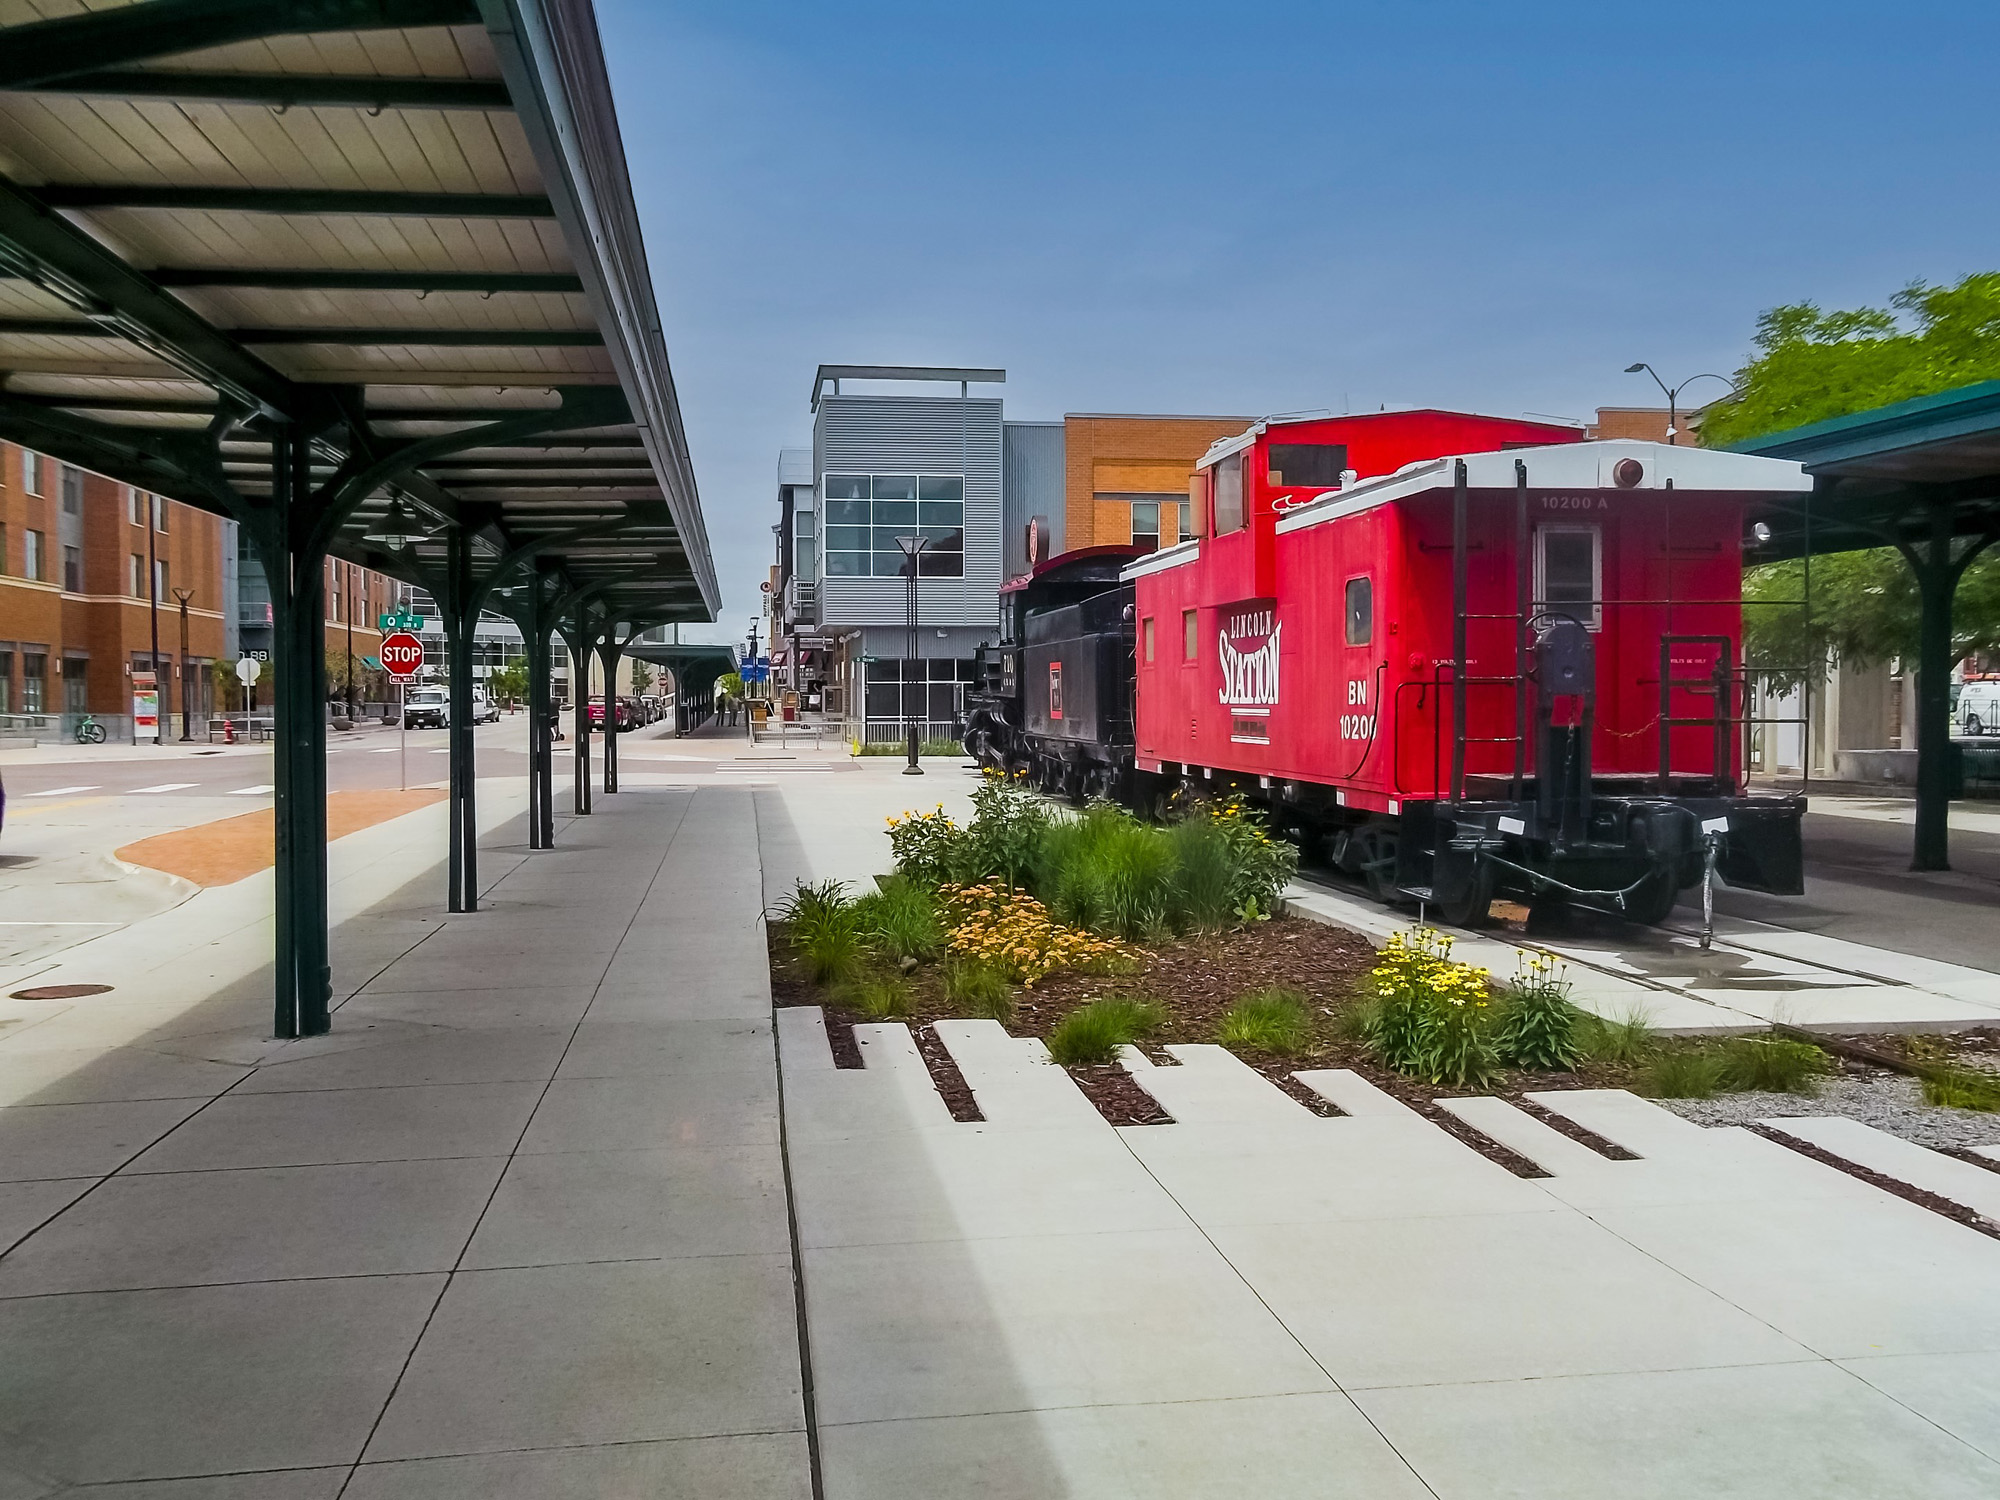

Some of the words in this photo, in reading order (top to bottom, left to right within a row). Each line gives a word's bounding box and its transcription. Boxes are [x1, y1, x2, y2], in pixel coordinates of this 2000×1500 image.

[1542, 496, 1591, 509] 10200
[1597, 497, 1608, 509] A
[387, 616, 396, 627] Q
[1230, 610, 1272, 639] LINCOLN
[383, 646, 421, 662] STOP
[1218, 619, 1282, 705] STATION
[1348, 680, 1367, 705] BN
[1339, 714, 1377, 741] 10200
